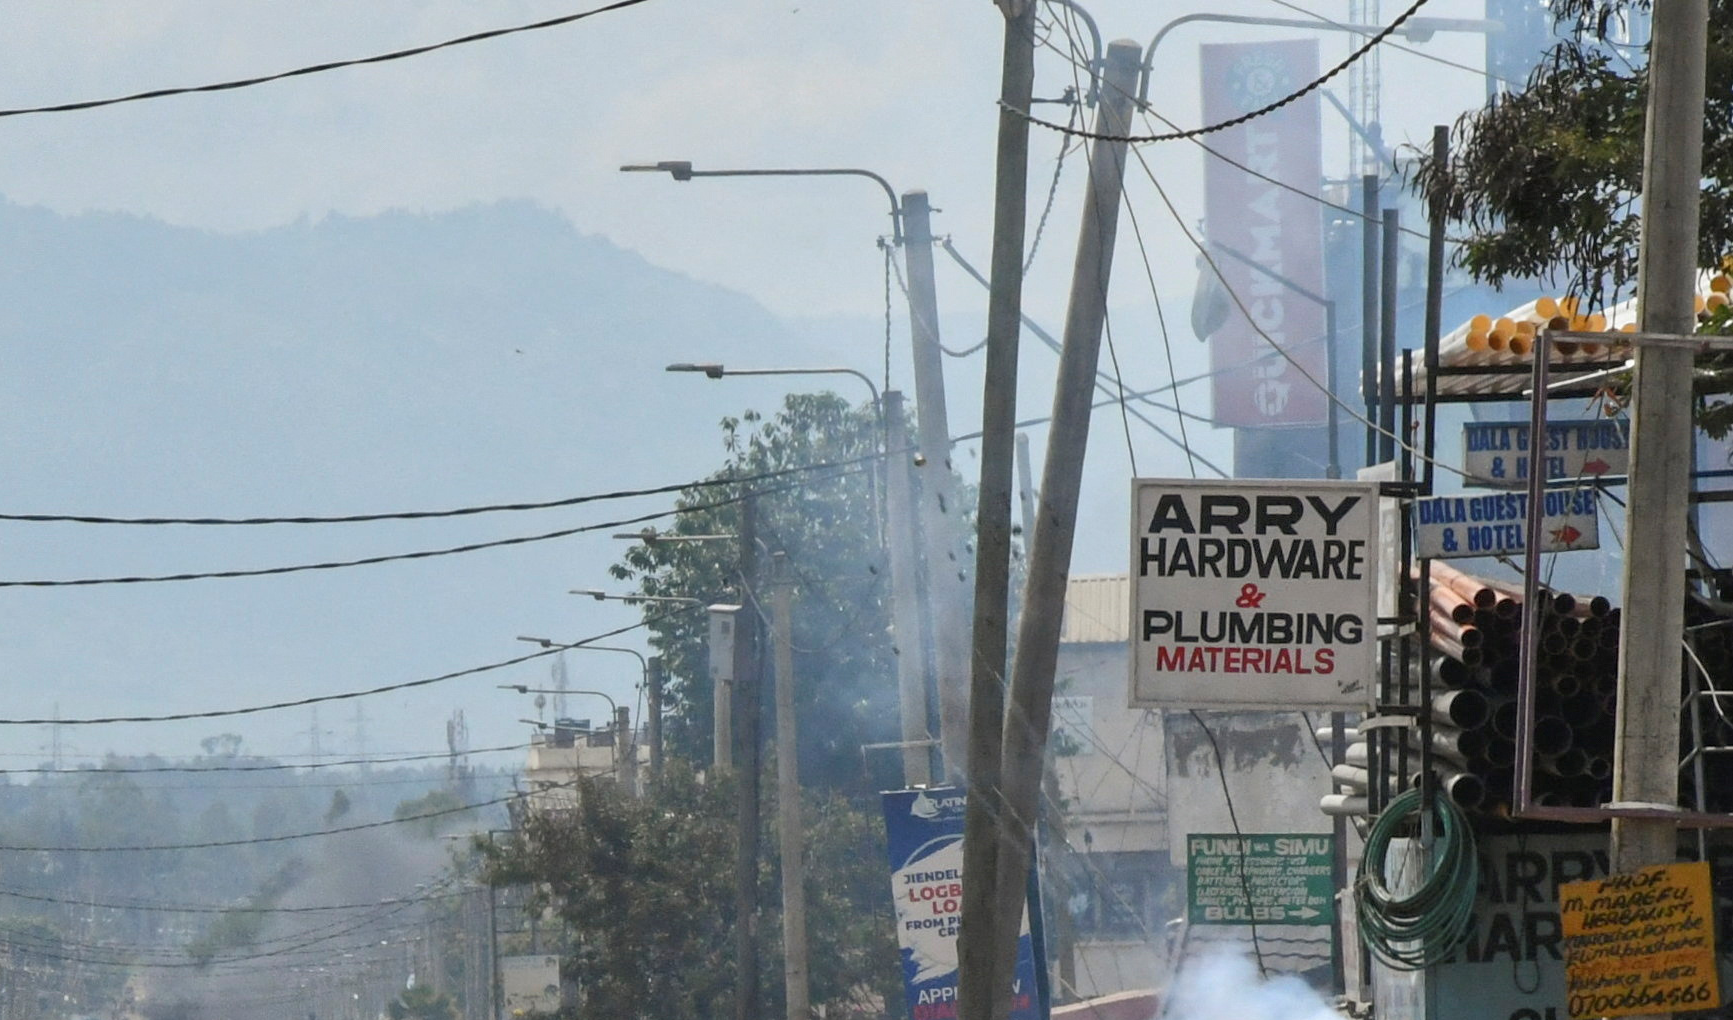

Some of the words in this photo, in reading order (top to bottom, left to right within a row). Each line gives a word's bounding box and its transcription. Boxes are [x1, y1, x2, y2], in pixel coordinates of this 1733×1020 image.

[1246, 124, 1290, 417] QUICKMART
[1469, 427, 1511, 452] DALA
[1516, 426, 1568, 451] GST
[1490, 456, 1506, 478] &
[1516, 456, 1567, 479] HEL
[1148, 494, 1361, 536] ARRY
[1419, 497, 1467, 525] DALA
[1469, 493, 1528, 522] GUEST
[1541, 489, 1594, 517] OUSE
[1442, 527, 1458, 551] &
[1467, 524, 1526, 551] HOTEL
[1140, 537, 1365, 580] HARDWARE
[1235, 583, 1266, 608] &
[1143, 610, 1364, 645] PLUMBING
[1156, 646, 1335, 674] MATERIALS
[924, 795, 967, 809] PLATIN
[1190, 838, 1251, 856] FUNDI
[1273, 838, 1330, 856] SIMU
[904, 869, 962, 884] JIENDEL
[909, 884, 964, 902] LOGB
[932, 899, 963, 915] LO
[1205, 906, 1286, 921] BULBS
[906, 918, 944, 931] FROM
[918, 986, 958, 1005] APP
